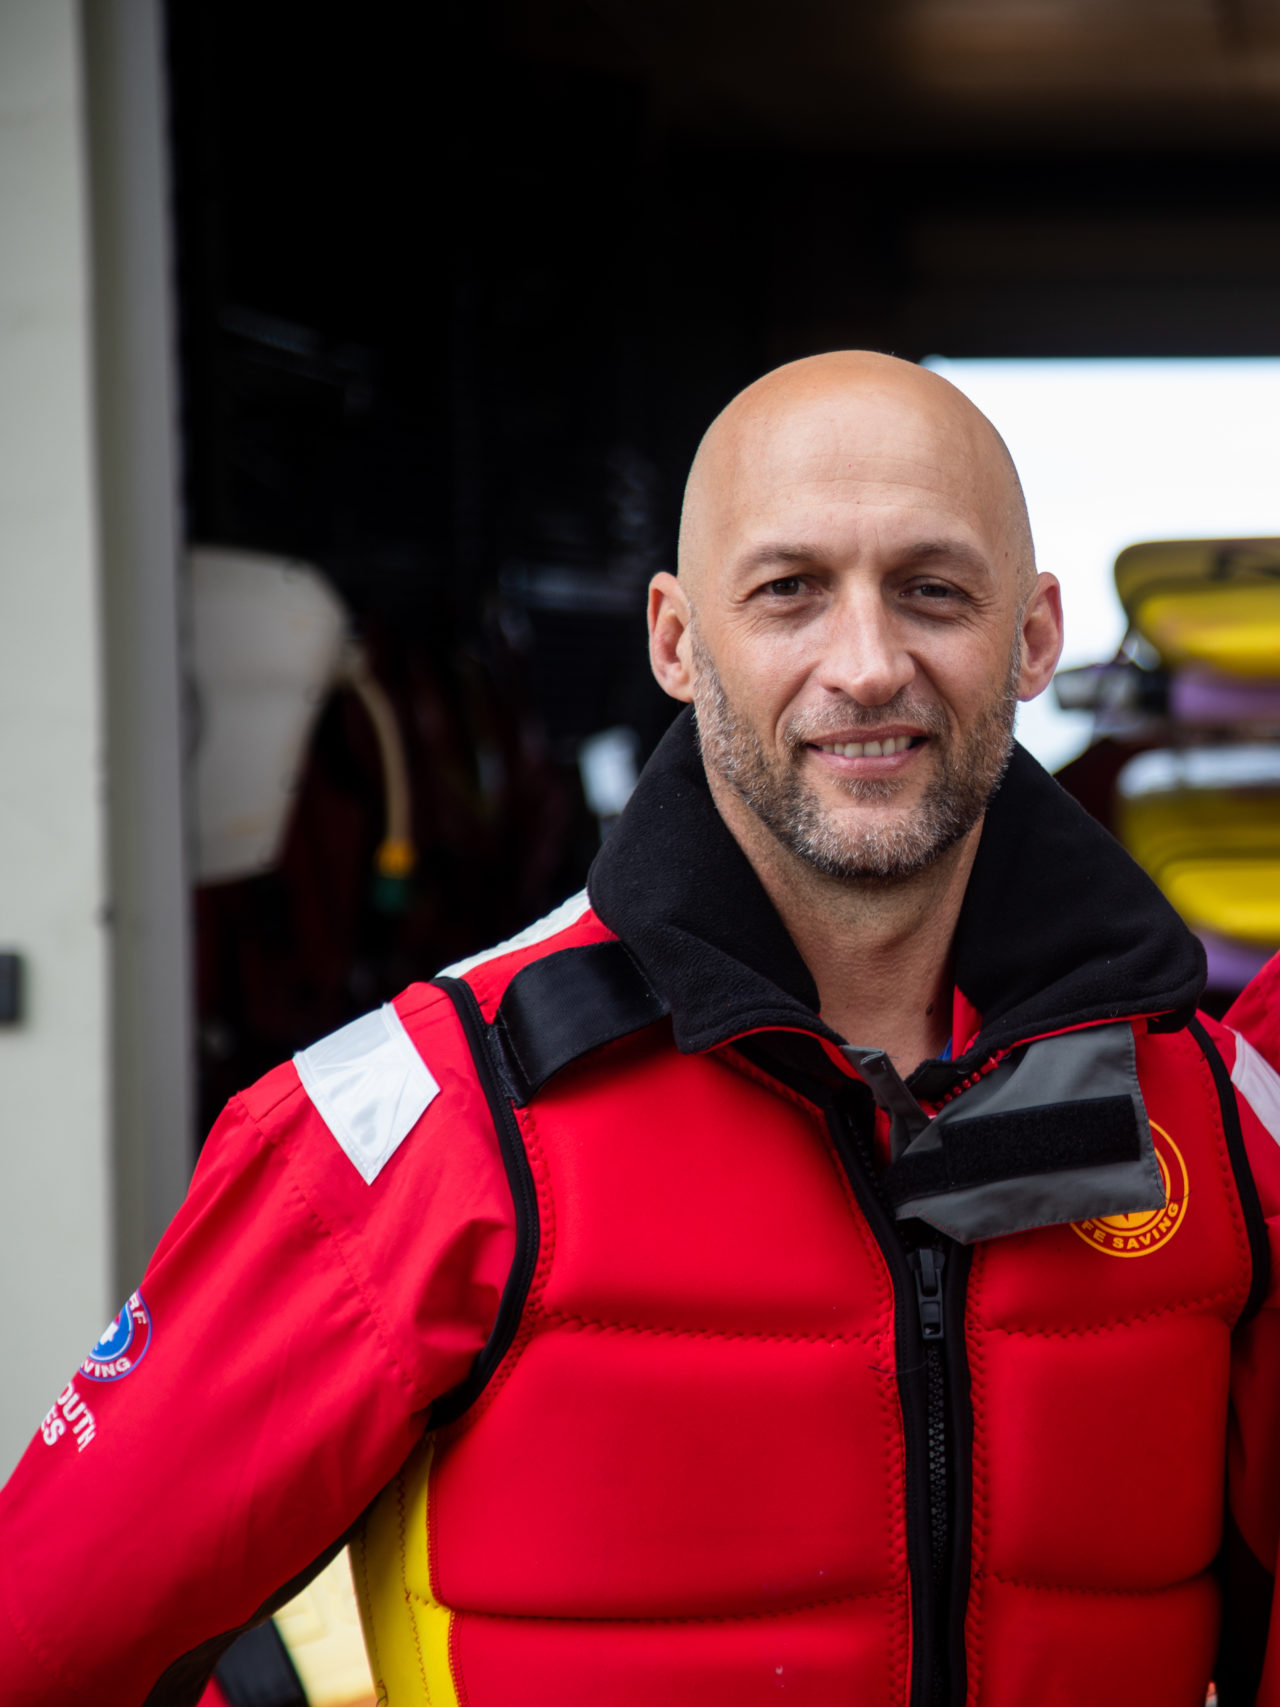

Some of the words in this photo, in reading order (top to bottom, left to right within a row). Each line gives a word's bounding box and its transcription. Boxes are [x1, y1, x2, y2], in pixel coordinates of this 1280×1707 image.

[1081, 1221, 1106, 1243] FE
[1113, 1202, 1179, 1249] SAVING
[128, 1291, 147, 1325] RF
[80, 1357, 132, 1378] VING
[57, 1381, 96, 1453] OUTH
